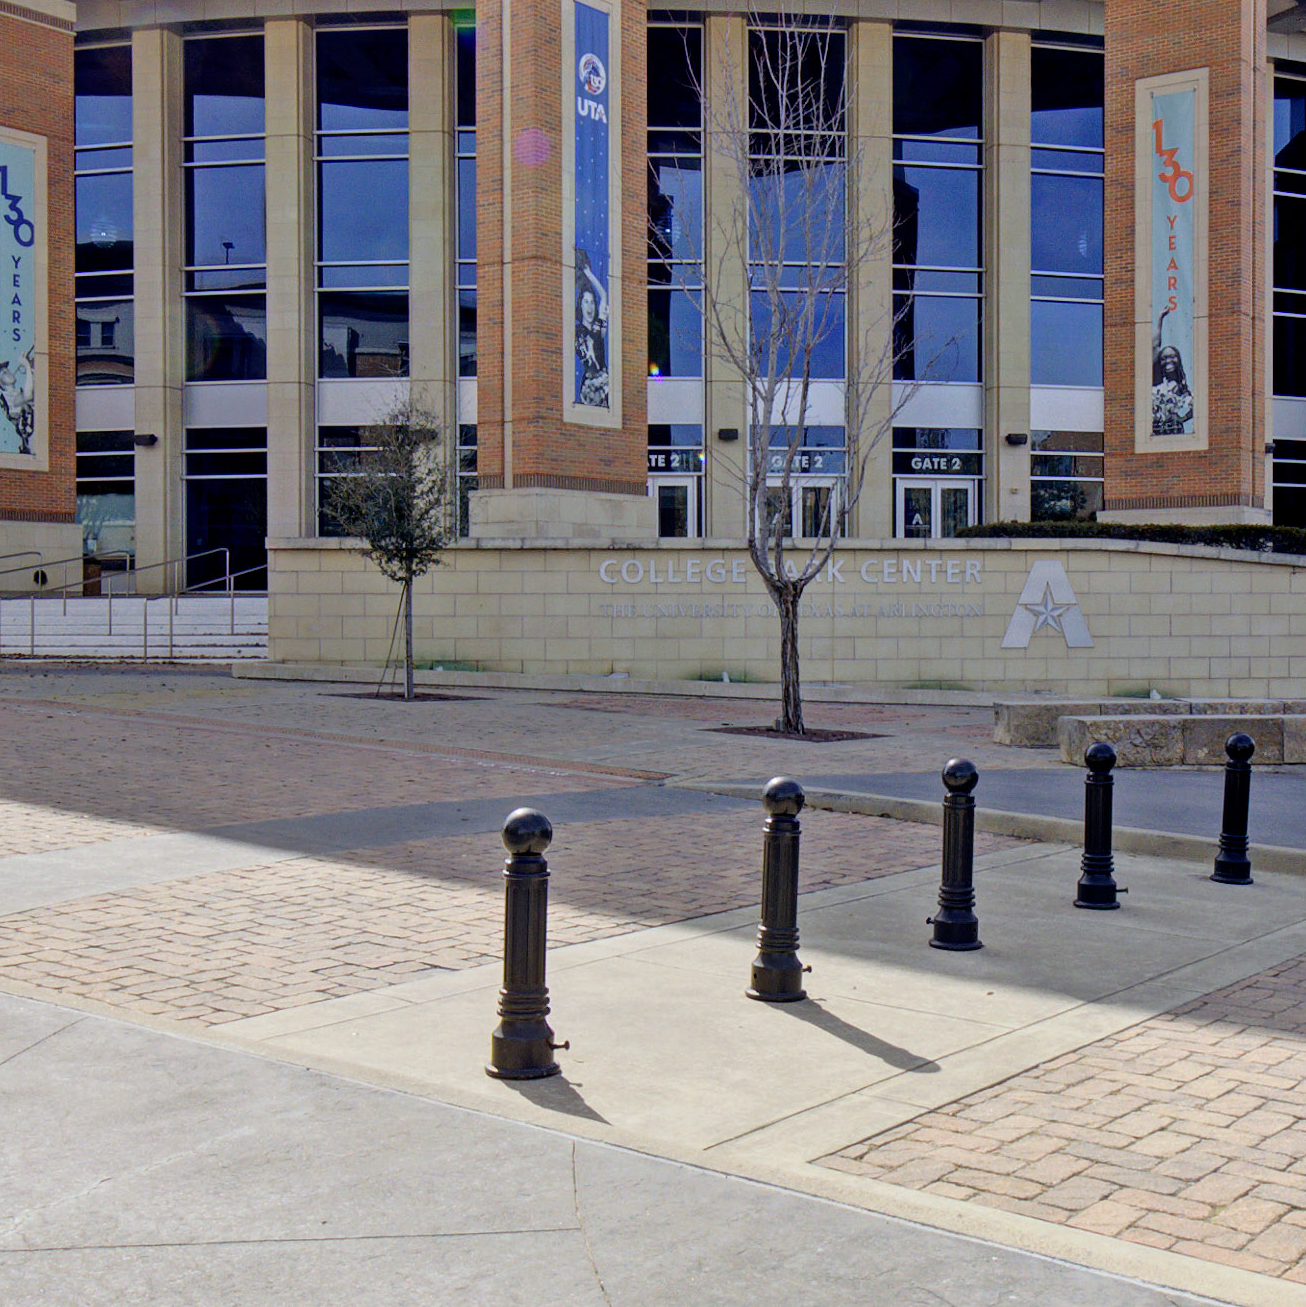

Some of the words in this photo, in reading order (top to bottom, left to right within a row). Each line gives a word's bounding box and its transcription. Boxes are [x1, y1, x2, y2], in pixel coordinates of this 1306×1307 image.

[577, 96, 607, 124] UTA
[1152, 119, 1194, 203] 130
[1166, 214, 1179, 311] YEARS
[11, 254, 23, 342] YEARS
[648, 454, 666, 467] TE
[670, 453, 680, 467] 2
[772, 455, 810, 468] GTE
[814, 455, 823, 468] 2
[911, 457, 947, 470] GATE
[952, 457, 961, 470] 2
[599, 559, 747, 583] COLLEGE
[860, 559, 982, 583] CENTER
[601, 604, 638, 618] THE
[644, 604, 755, 618] UNIVERSITY
[798, 604, 843, 618] EXAS
[848, 604, 870, 618] AT
[876, 603, 983, 618] ARLINGTON
